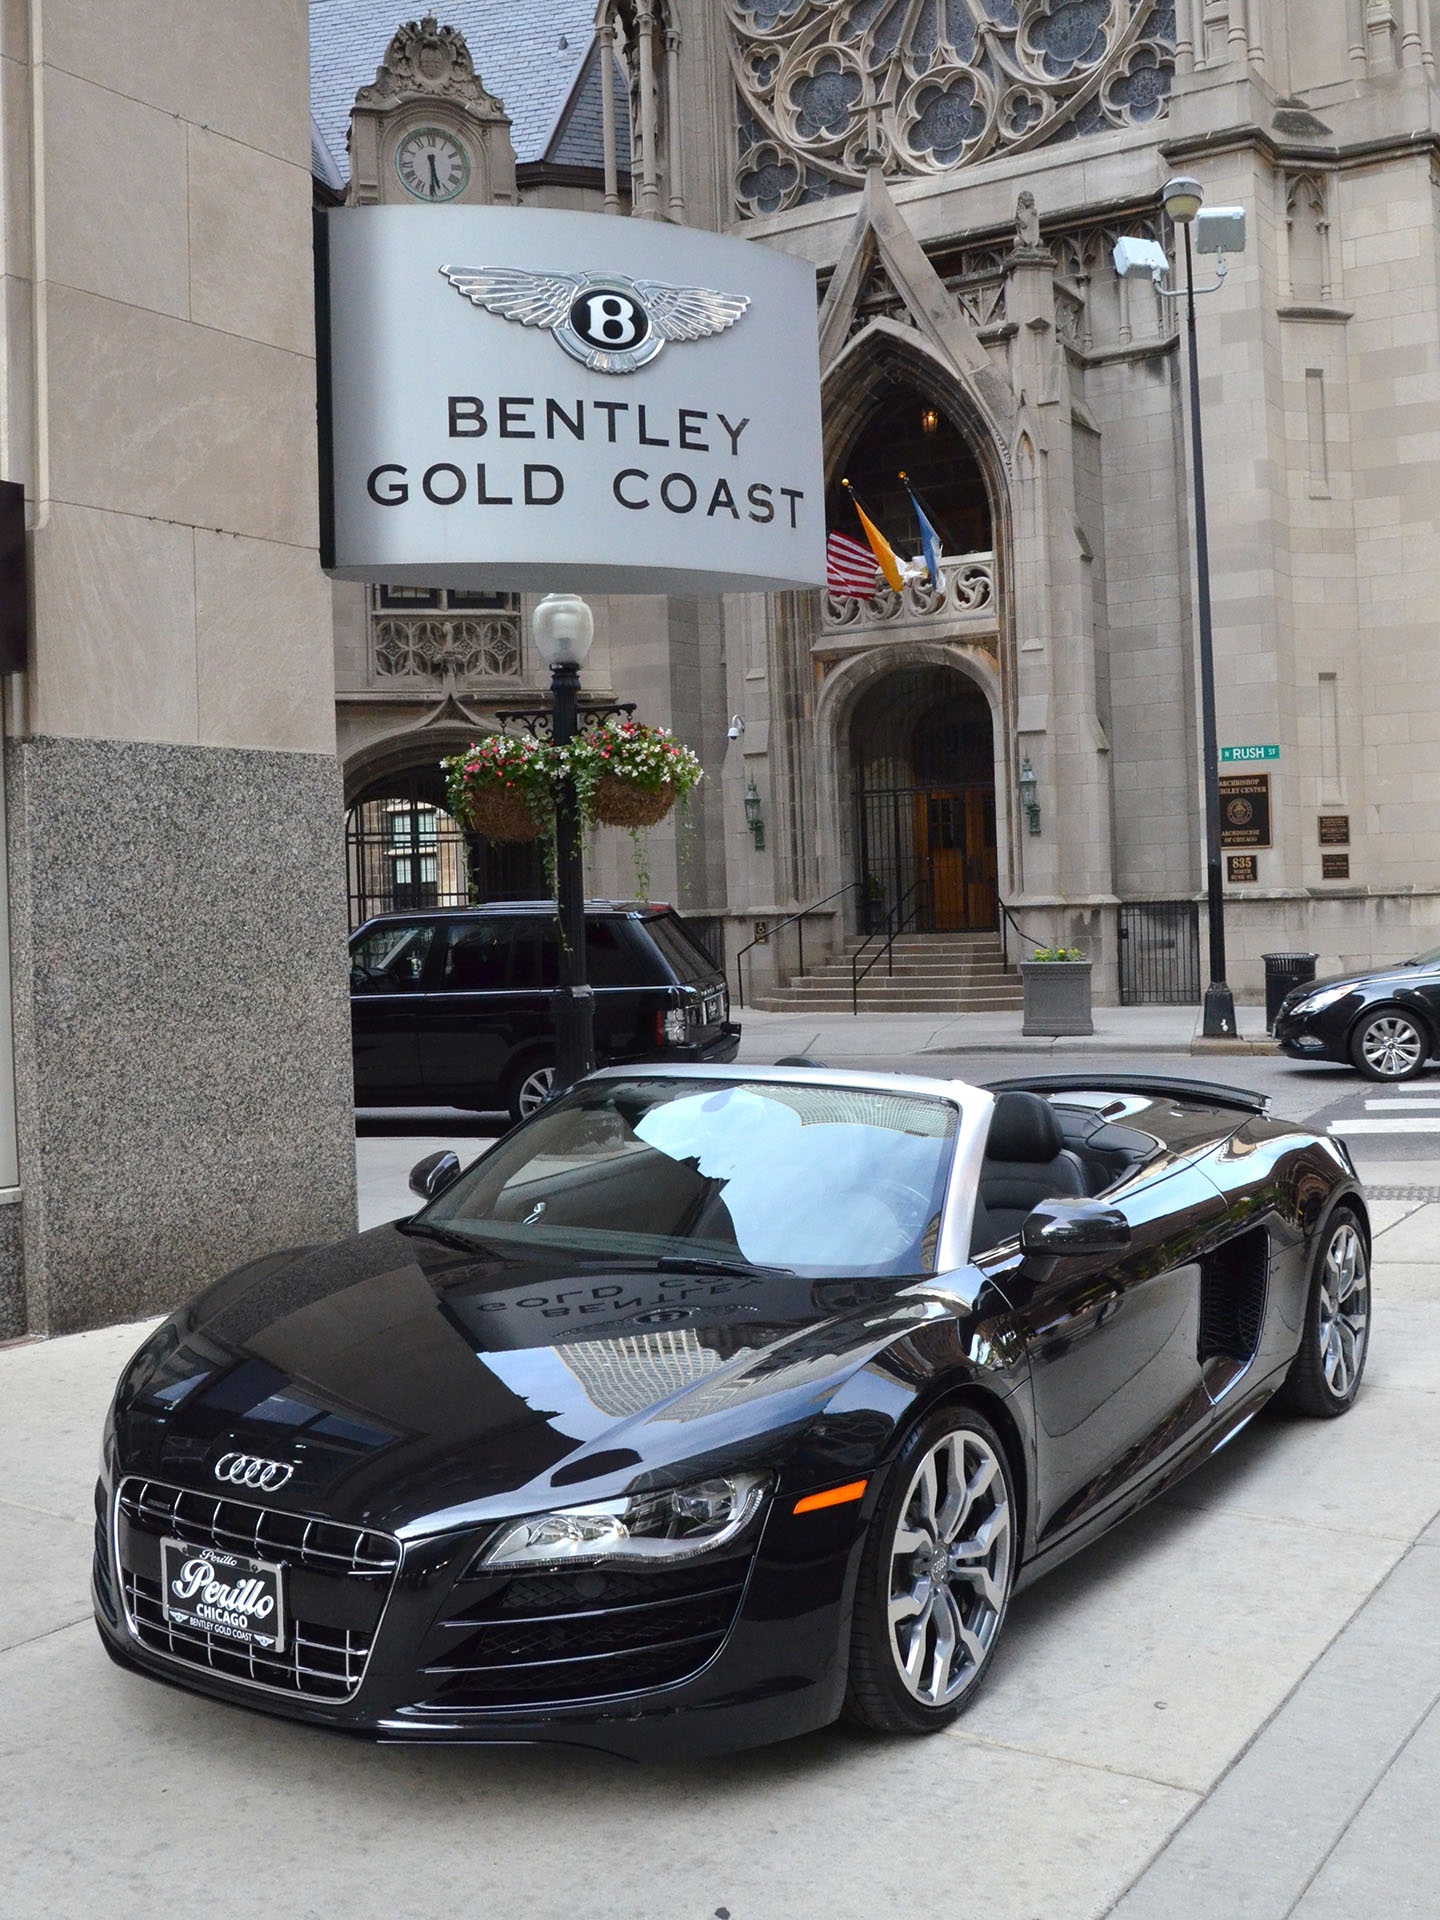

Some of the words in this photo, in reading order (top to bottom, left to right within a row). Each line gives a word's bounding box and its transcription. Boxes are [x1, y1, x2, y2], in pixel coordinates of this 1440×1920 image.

[587, 295, 636, 344] B
[448, 396, 751, 456] BENTLEY
[367, 463, 564, 507] GOLD
[613, 468, 804, 529] COAST
[1232, 747, 1265, 760] RUSH
[1268, 748, 1276, 756] ST
[1240, 786, 1267, 794] CENTER
[1232, 856, 1252, 869] 835
[199, 1549, 238, 1567] Perillo
[171, 1558, 275, 1619] Perillo
[189, 1616, 214, 1632] BENTLEY
[214, 1623, 232, 1636] GOLD
[232, 1629, 253, 1642] COAST
[196, 1603, 248, 1629] CHICAGO
